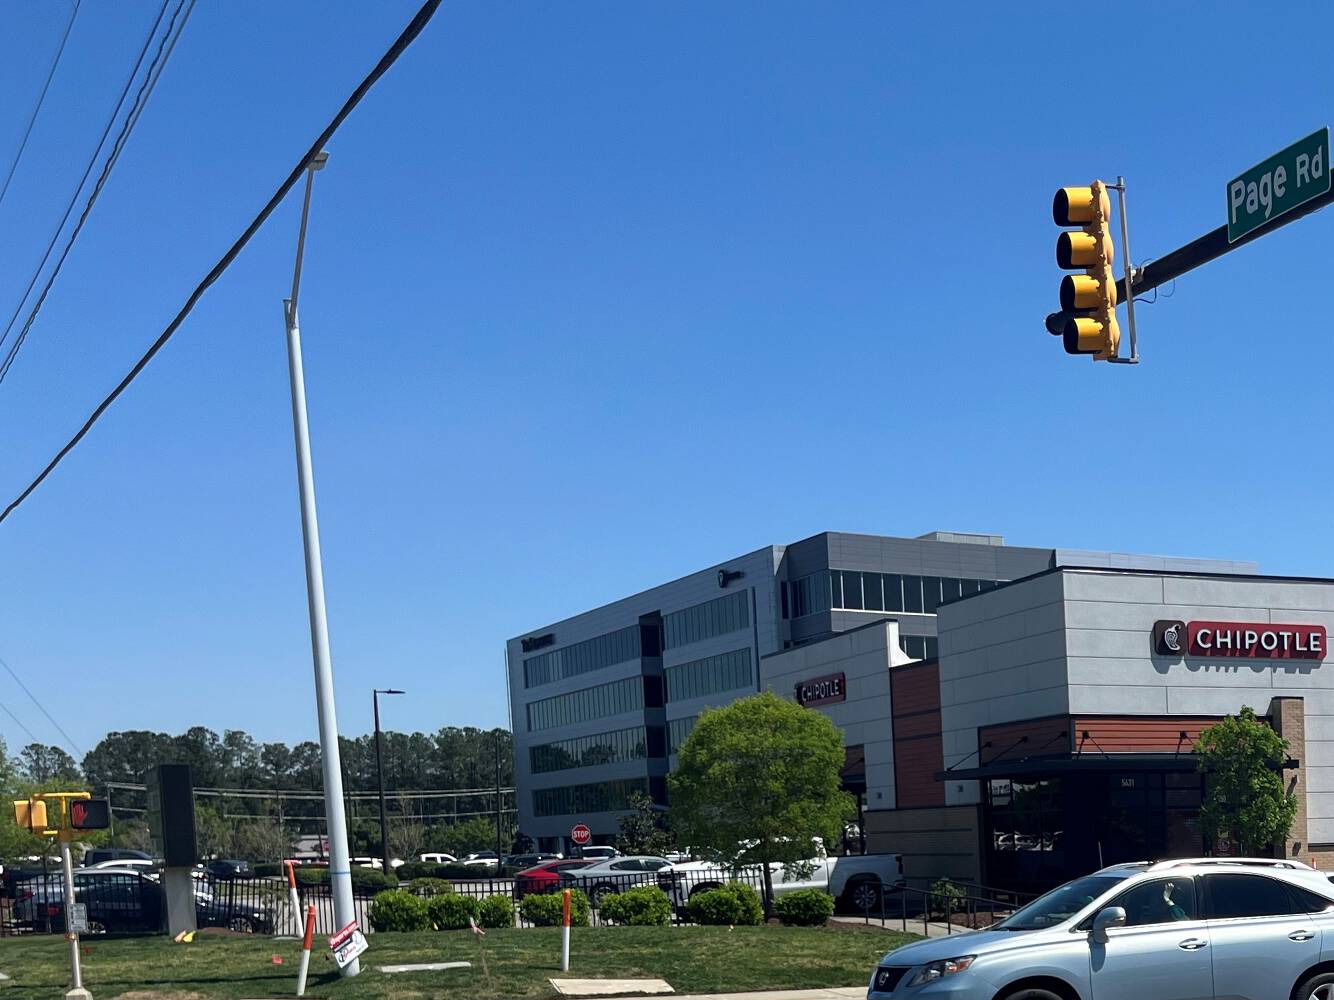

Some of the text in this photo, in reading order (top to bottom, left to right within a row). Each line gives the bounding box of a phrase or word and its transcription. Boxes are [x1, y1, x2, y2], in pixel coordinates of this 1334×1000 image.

[1231, 145, 1323, 224] Page Rd
[1196, 629, 1322, 652] CHIPOTLE
[801, 679, 840, 701] CHIPOTLE
[573, 830, 590, 839] STOP
